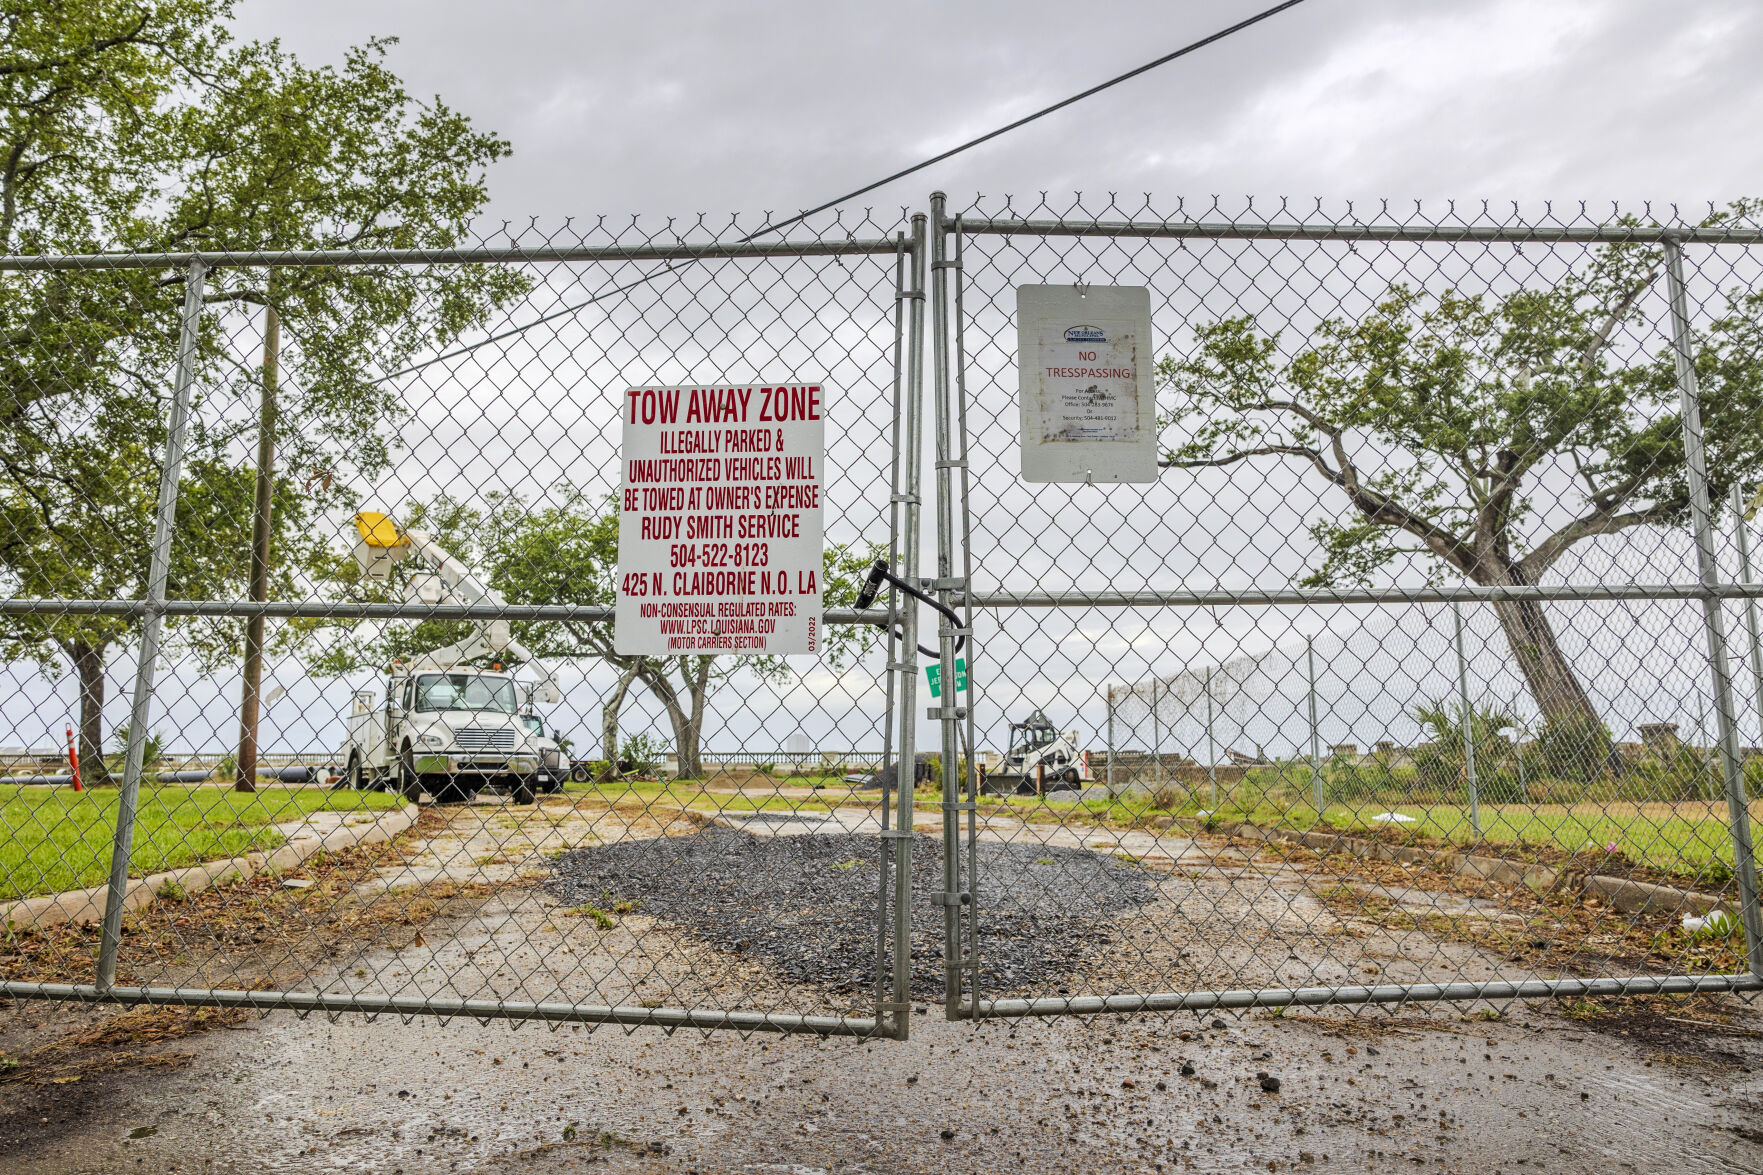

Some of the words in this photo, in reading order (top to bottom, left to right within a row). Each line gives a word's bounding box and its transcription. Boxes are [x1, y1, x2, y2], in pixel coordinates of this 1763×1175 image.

[1079, 351, 1097, 361] NO
[1046, 367, 1130, 379] TRESSPASSING
[628, 390, 680, 424] TOW
[686, 388, 752, 423] AWAY
[760, 386, 820, 421] ZONE
[659, 430, 721, 454] ILLEGALLY
[725, 429, 771, 453] PARKED
[776, 428, 784, 451] &
[629, 458, 720, 483] UNAUTHORIZED
[725, 457, 781, 481] VEHICLES
[785, 456, 814, 480] WILL
[625, 488, 639, 511] BE
[642, 487, 684, 511] TOWED
[687, 487, 702, 510] AT
[706, 485, 761, 510] OWNER'S
[765, 485, 819, 509] EXPENSE
[641, 516, 682, 540] RUDY
[686, 515, 733, 539] SMITH
[738, 514, 799, 538] SERVICE
[670, 543, 768, 568] 504-522-8123
[622, 573, 647, 596] 425
[652, 572, 667, 596] N.
[673, 571, 756, 596] CLAIBORNE
[761, 571, 793, 595] N.O.
[798, 571, 817, 595] LA
[640, 602, 715, 618] NON-CONSENSUAL
[718, 602, 766, 617] REGULATED
[768, 602, 797, 617] RATES:
[660, 619, 776, 635] WWW.LPSC.LOUISIANA.GOV
[808, 616, 816, 652] 03/2022
[667, 636, 696, 651] (MOTOR
[697, 636, 733, 650] CARRIERS
[734, 635, 767, 650] SECTION)
